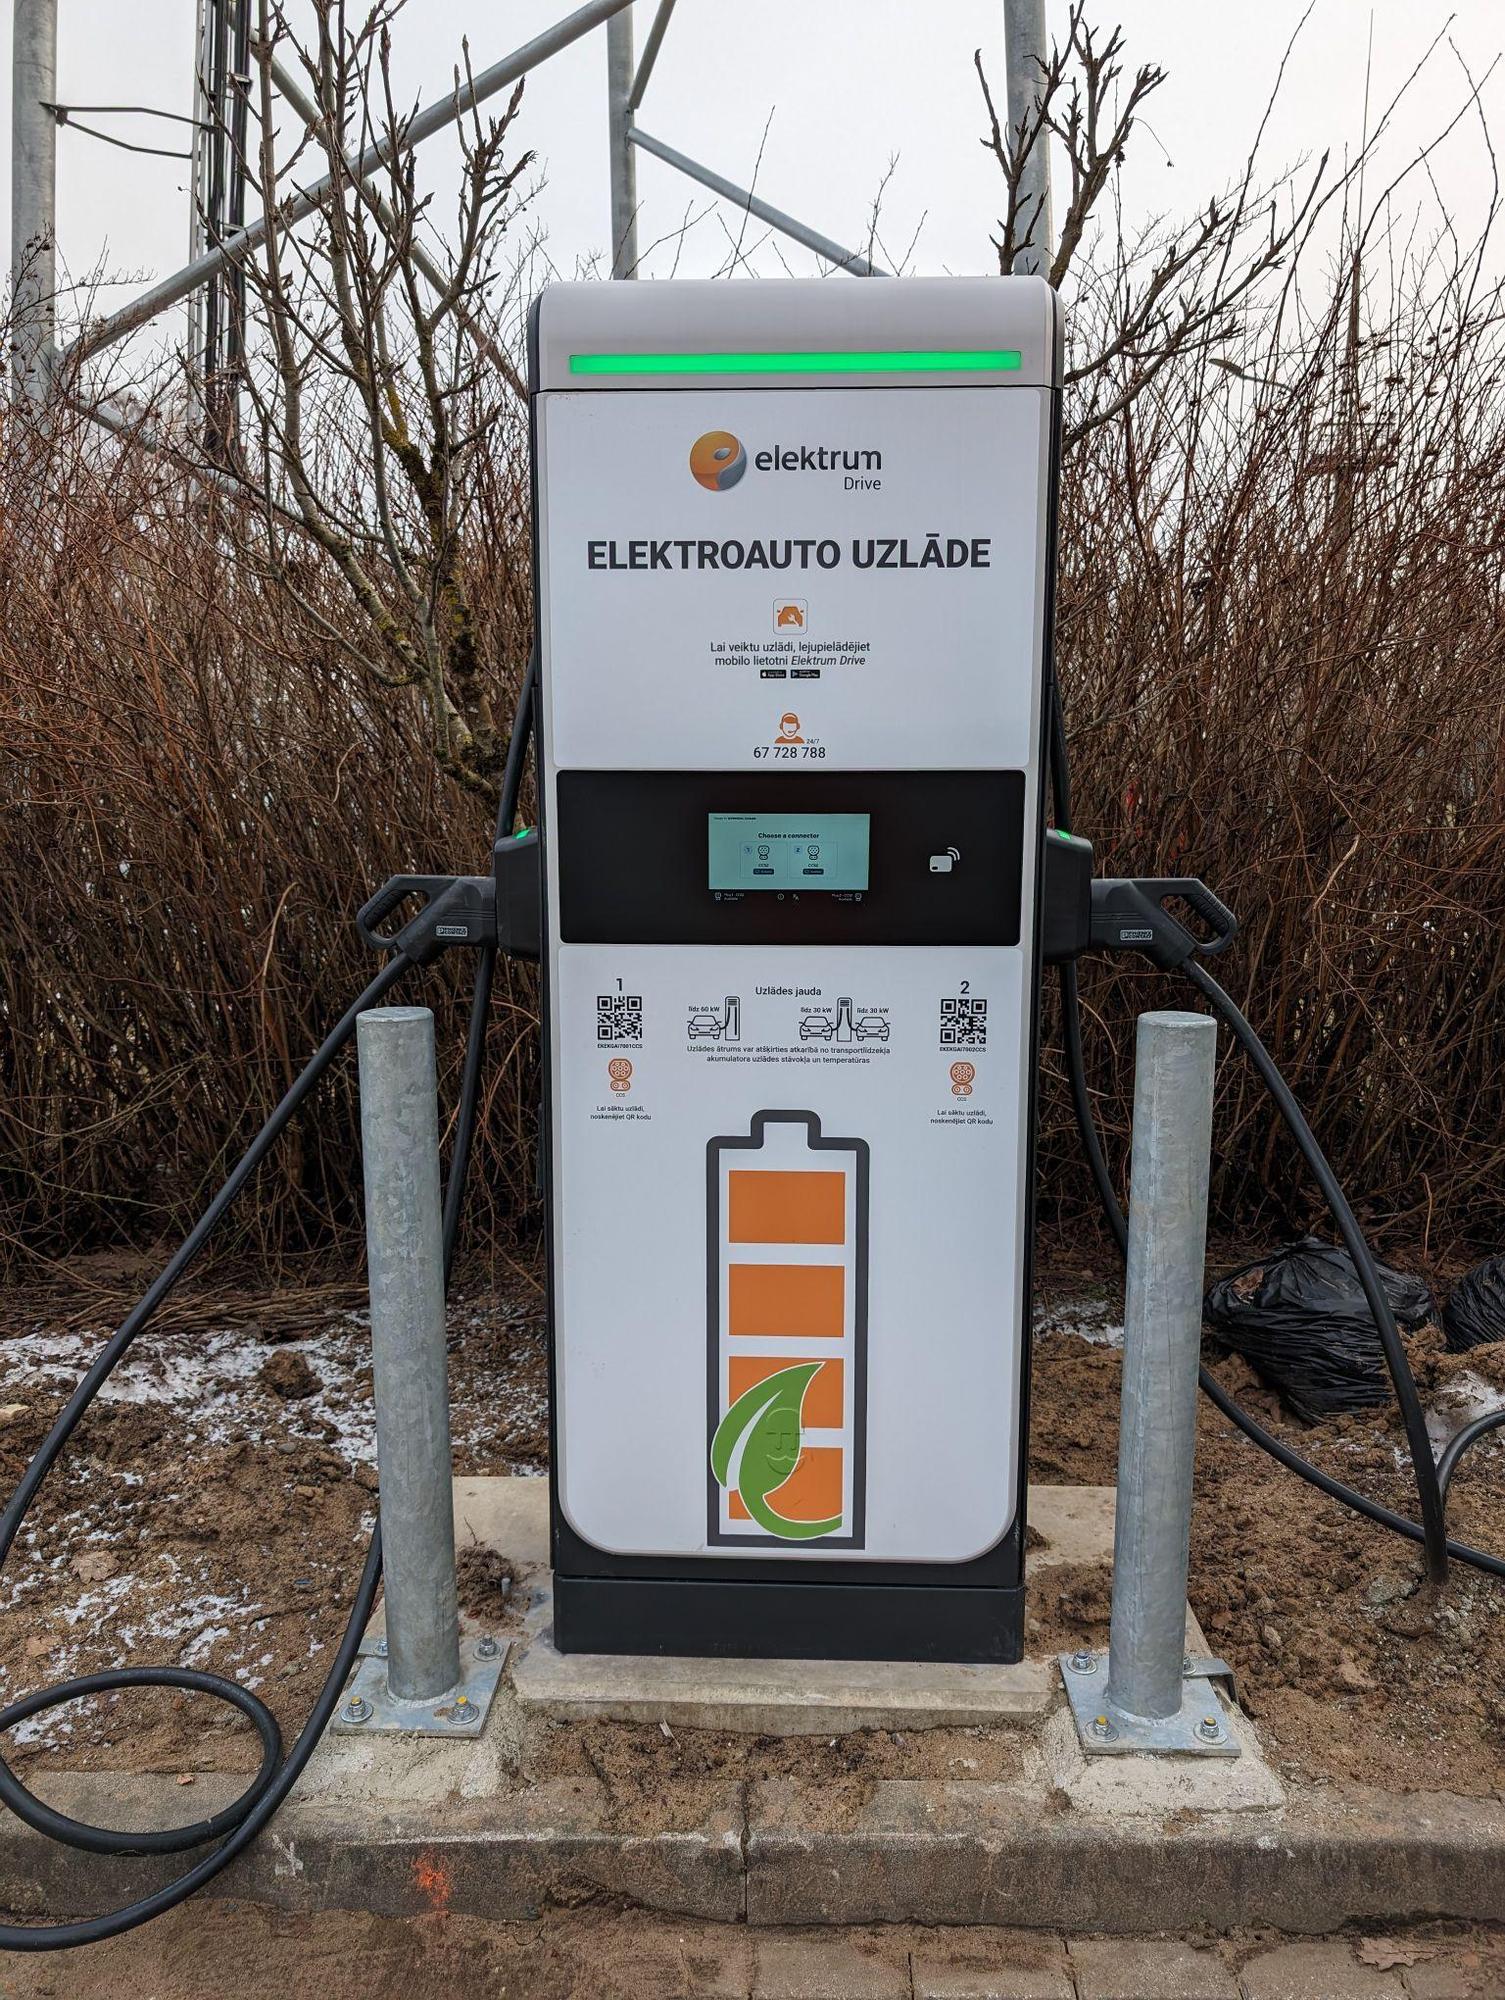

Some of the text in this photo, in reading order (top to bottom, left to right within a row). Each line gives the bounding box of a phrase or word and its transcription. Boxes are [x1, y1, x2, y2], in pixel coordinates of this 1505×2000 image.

[754, 445, 882, 472] elektrum
[843, 476, 882, 491] Drive
[587, 533, 992, 570] ELEKTROAUTO UZLĀDE
[710, 641, 871, 654] Lai veiktu uzlādi, lejupielādējiet
[715, 656, 866, 666] mobilo lietotni Elektrum Drive
[753, 746, 826, 759] 67 728 788
[616, 978, 623, 991] 1
[755, 985, 822, 997] Uzlādes jauda
[960, 980, 970, 994] 2
[781, 1056, 811, 1064] stāvokļa
[590, 1113, 625, 1121] noskenējiet
